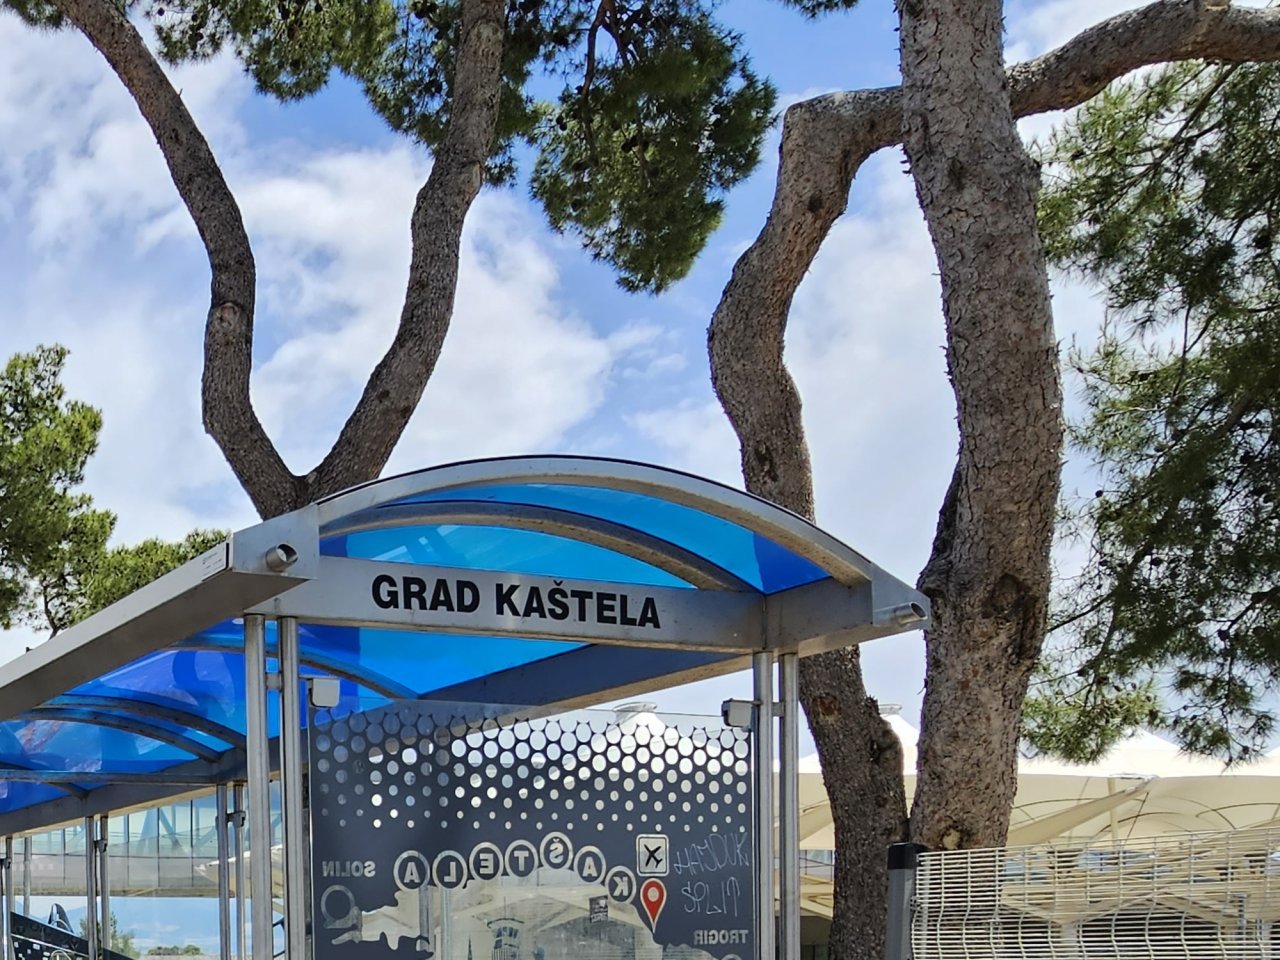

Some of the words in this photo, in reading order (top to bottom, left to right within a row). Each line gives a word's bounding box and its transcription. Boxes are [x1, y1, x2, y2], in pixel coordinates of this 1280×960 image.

[371, 574, 480, 613] GRAD
[496, 580, 661, 629] KAŠTELA
[673, 832, 749, 876] HAJDUK
[681, 876, 741, 917] SPLIT
